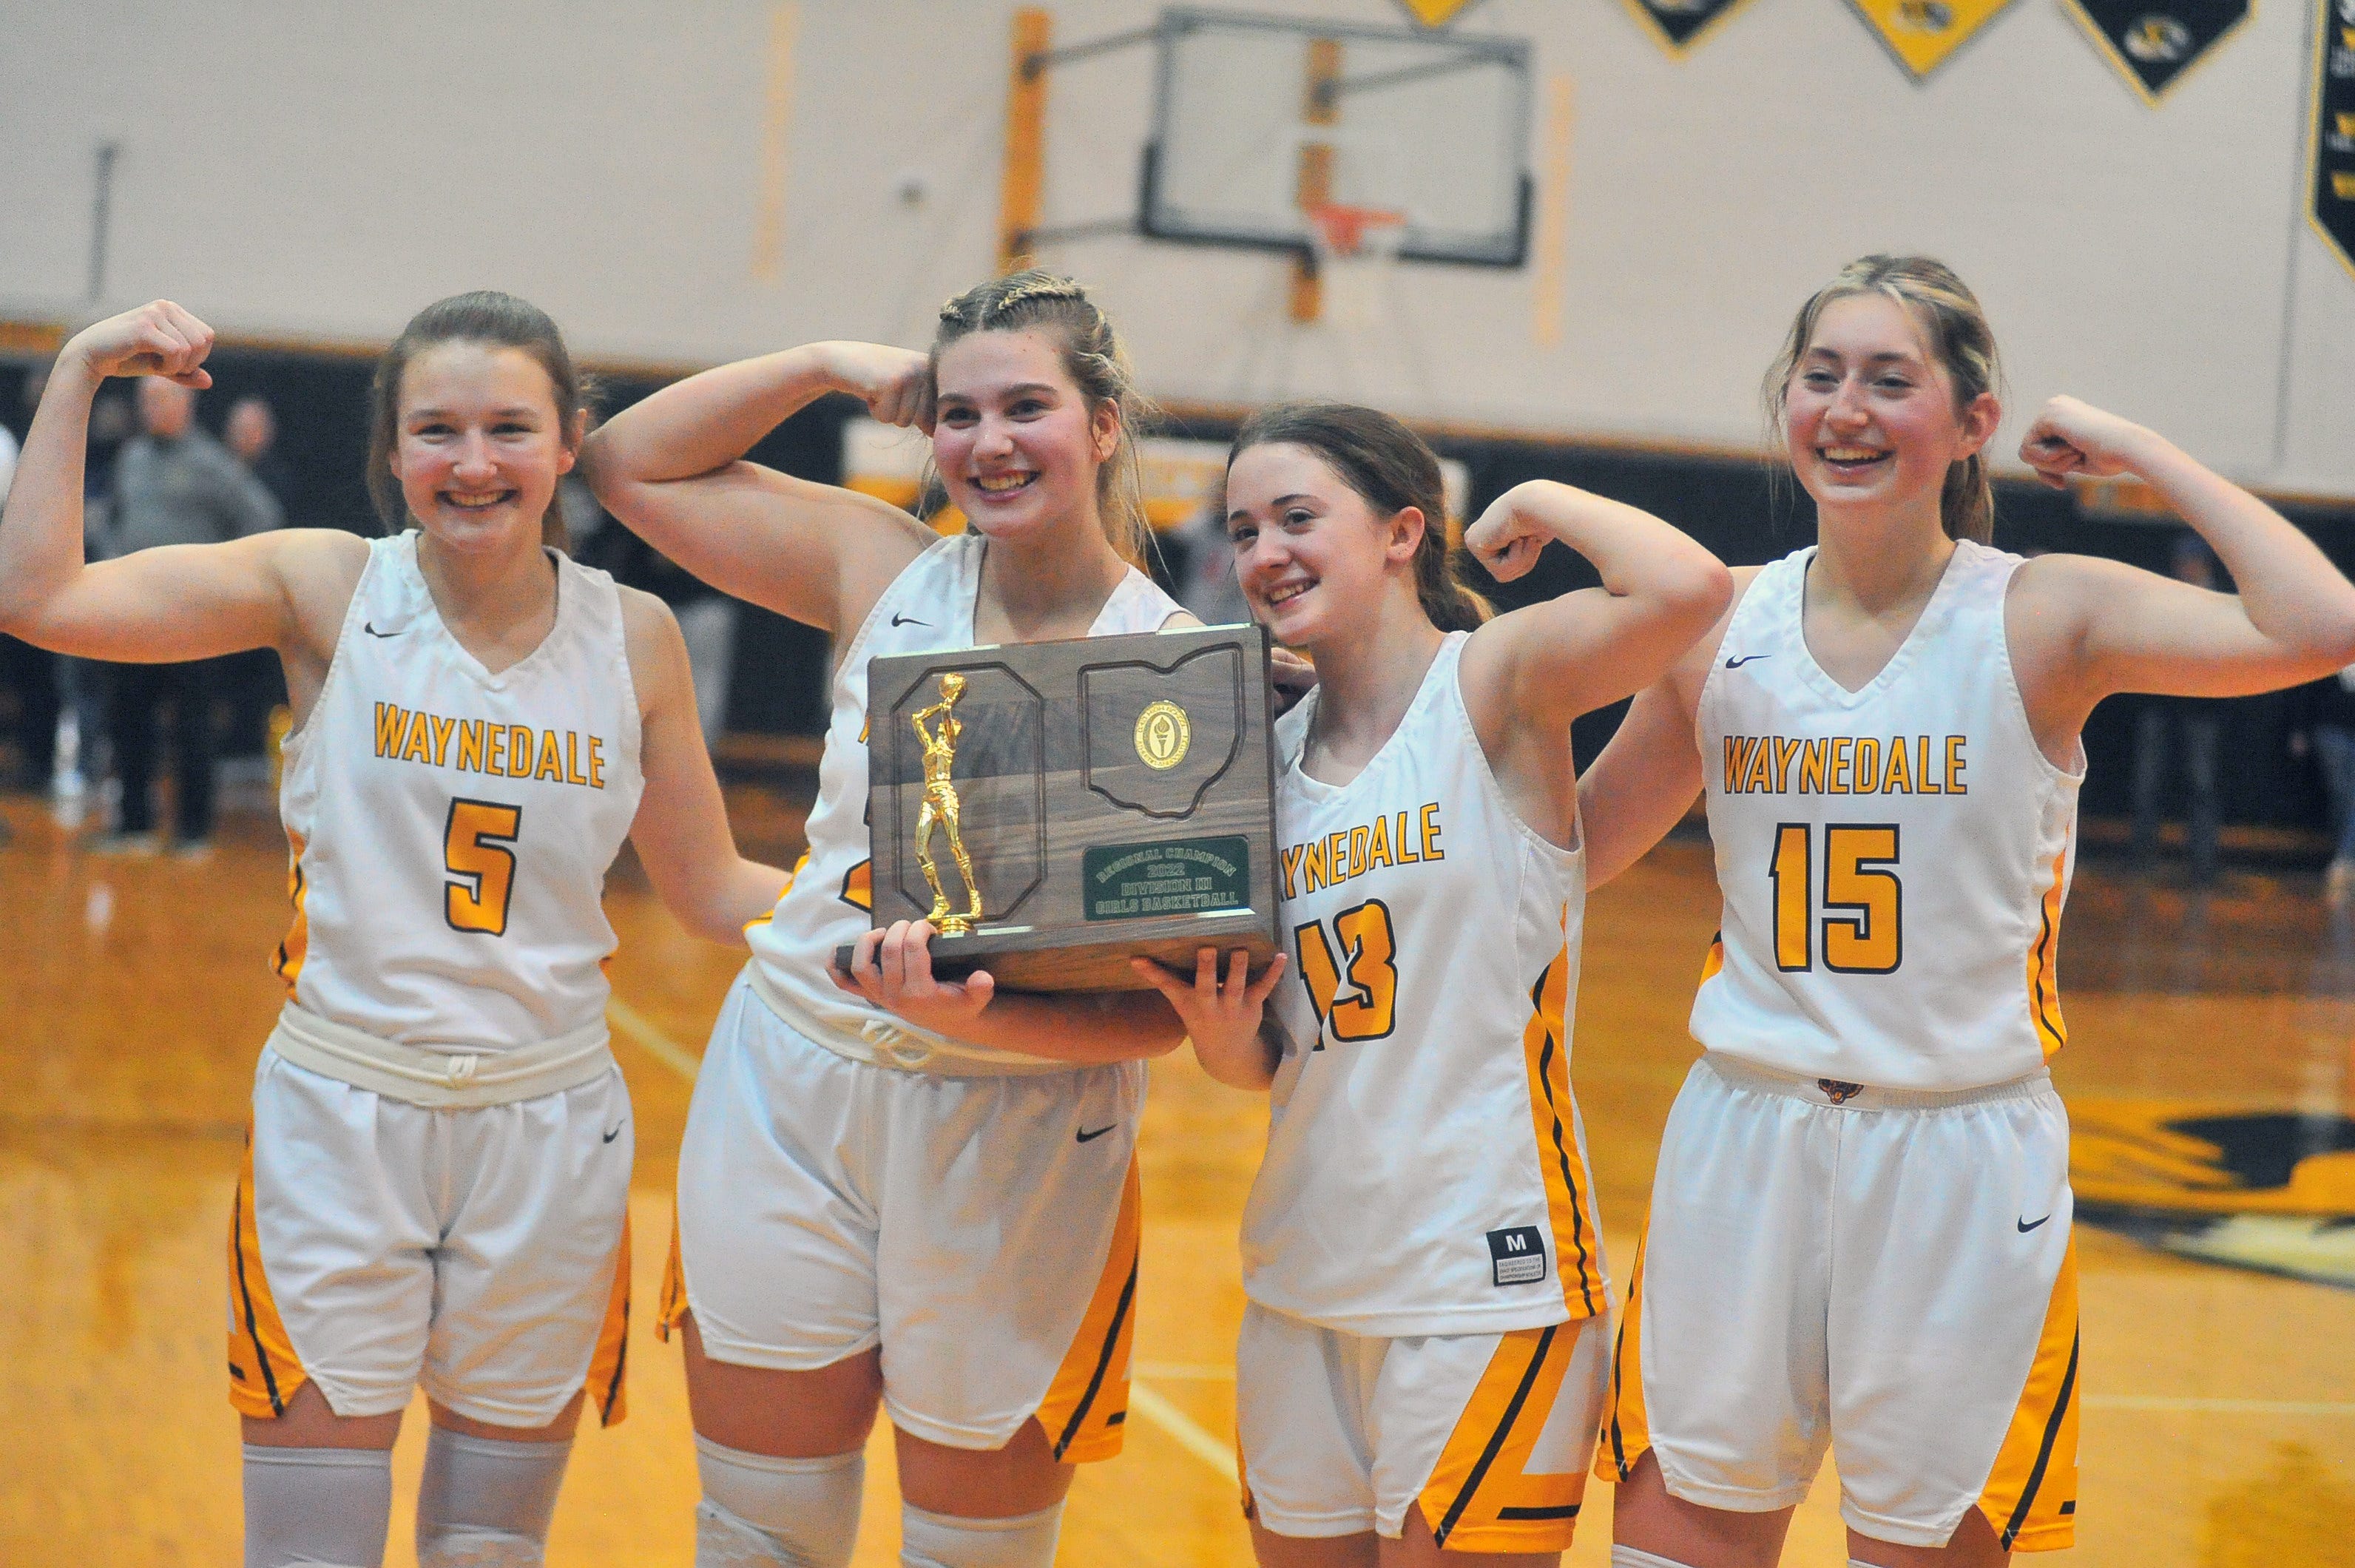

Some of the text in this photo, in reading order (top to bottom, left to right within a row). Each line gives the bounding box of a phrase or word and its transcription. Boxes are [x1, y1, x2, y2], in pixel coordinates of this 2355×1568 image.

[374, 701, 605, 789] WAYNEDALE
[1723, 735, 1968, 795] WAYNEDALE
[443, 796, 522, 937] 5
[1096, 847, 1237, 884] REGIONAL CHAMPION
[1147, 862, 1186, 878] 2022
[1280, 801, 1445, 903] YNEDALE
[1095, 891, 1239, 915] GIRLS BASKETBALL
[1121, 876, 1212, 896] DIVISION III
[1768, 822, 1903, 975] 15
[1294, 897, 1399, 1052] 13
[1505, 1234, 1527, 1252] M
